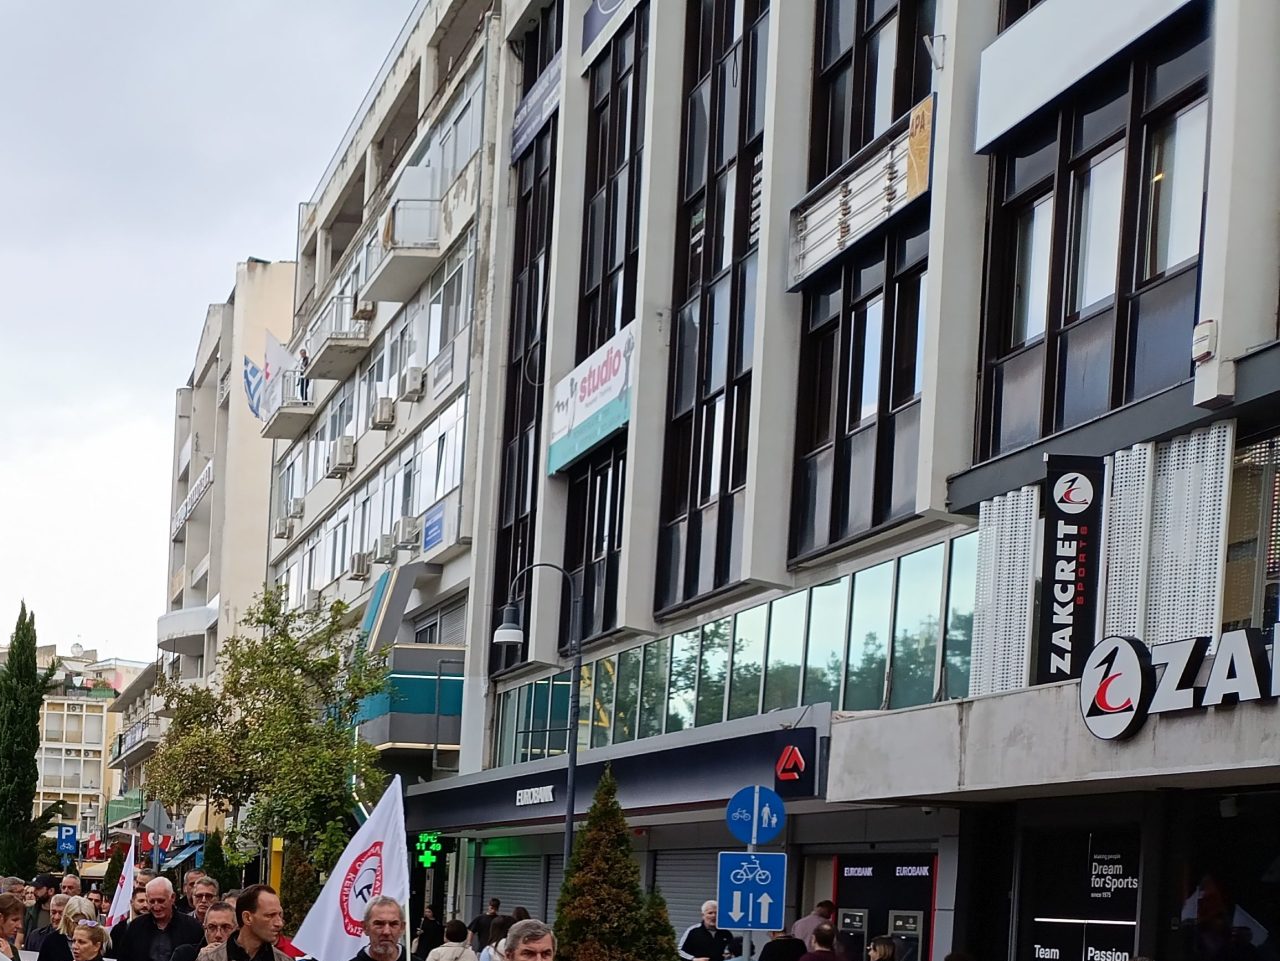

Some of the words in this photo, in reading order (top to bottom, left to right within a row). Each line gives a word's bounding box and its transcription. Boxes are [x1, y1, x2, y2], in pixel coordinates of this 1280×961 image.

[579, 346, 621, 402] studio
[1076, 525, 1088, 605] SPORTS
[1050, 520, 1078, 675] ZAKCRET
[516, 785, 554, 806] EUROBANK
[62, 827, 73, 839] P
[844, 867, 873, 876] EUROBANK
[896, 866, 929, 876] EUROBANK
[1092, 862, 1123, 875] Dream
[1091, 875, 1105, 888] for
[1105, 875, 1138, 892] Sports
[1034, 944, 1060, 960] Team
